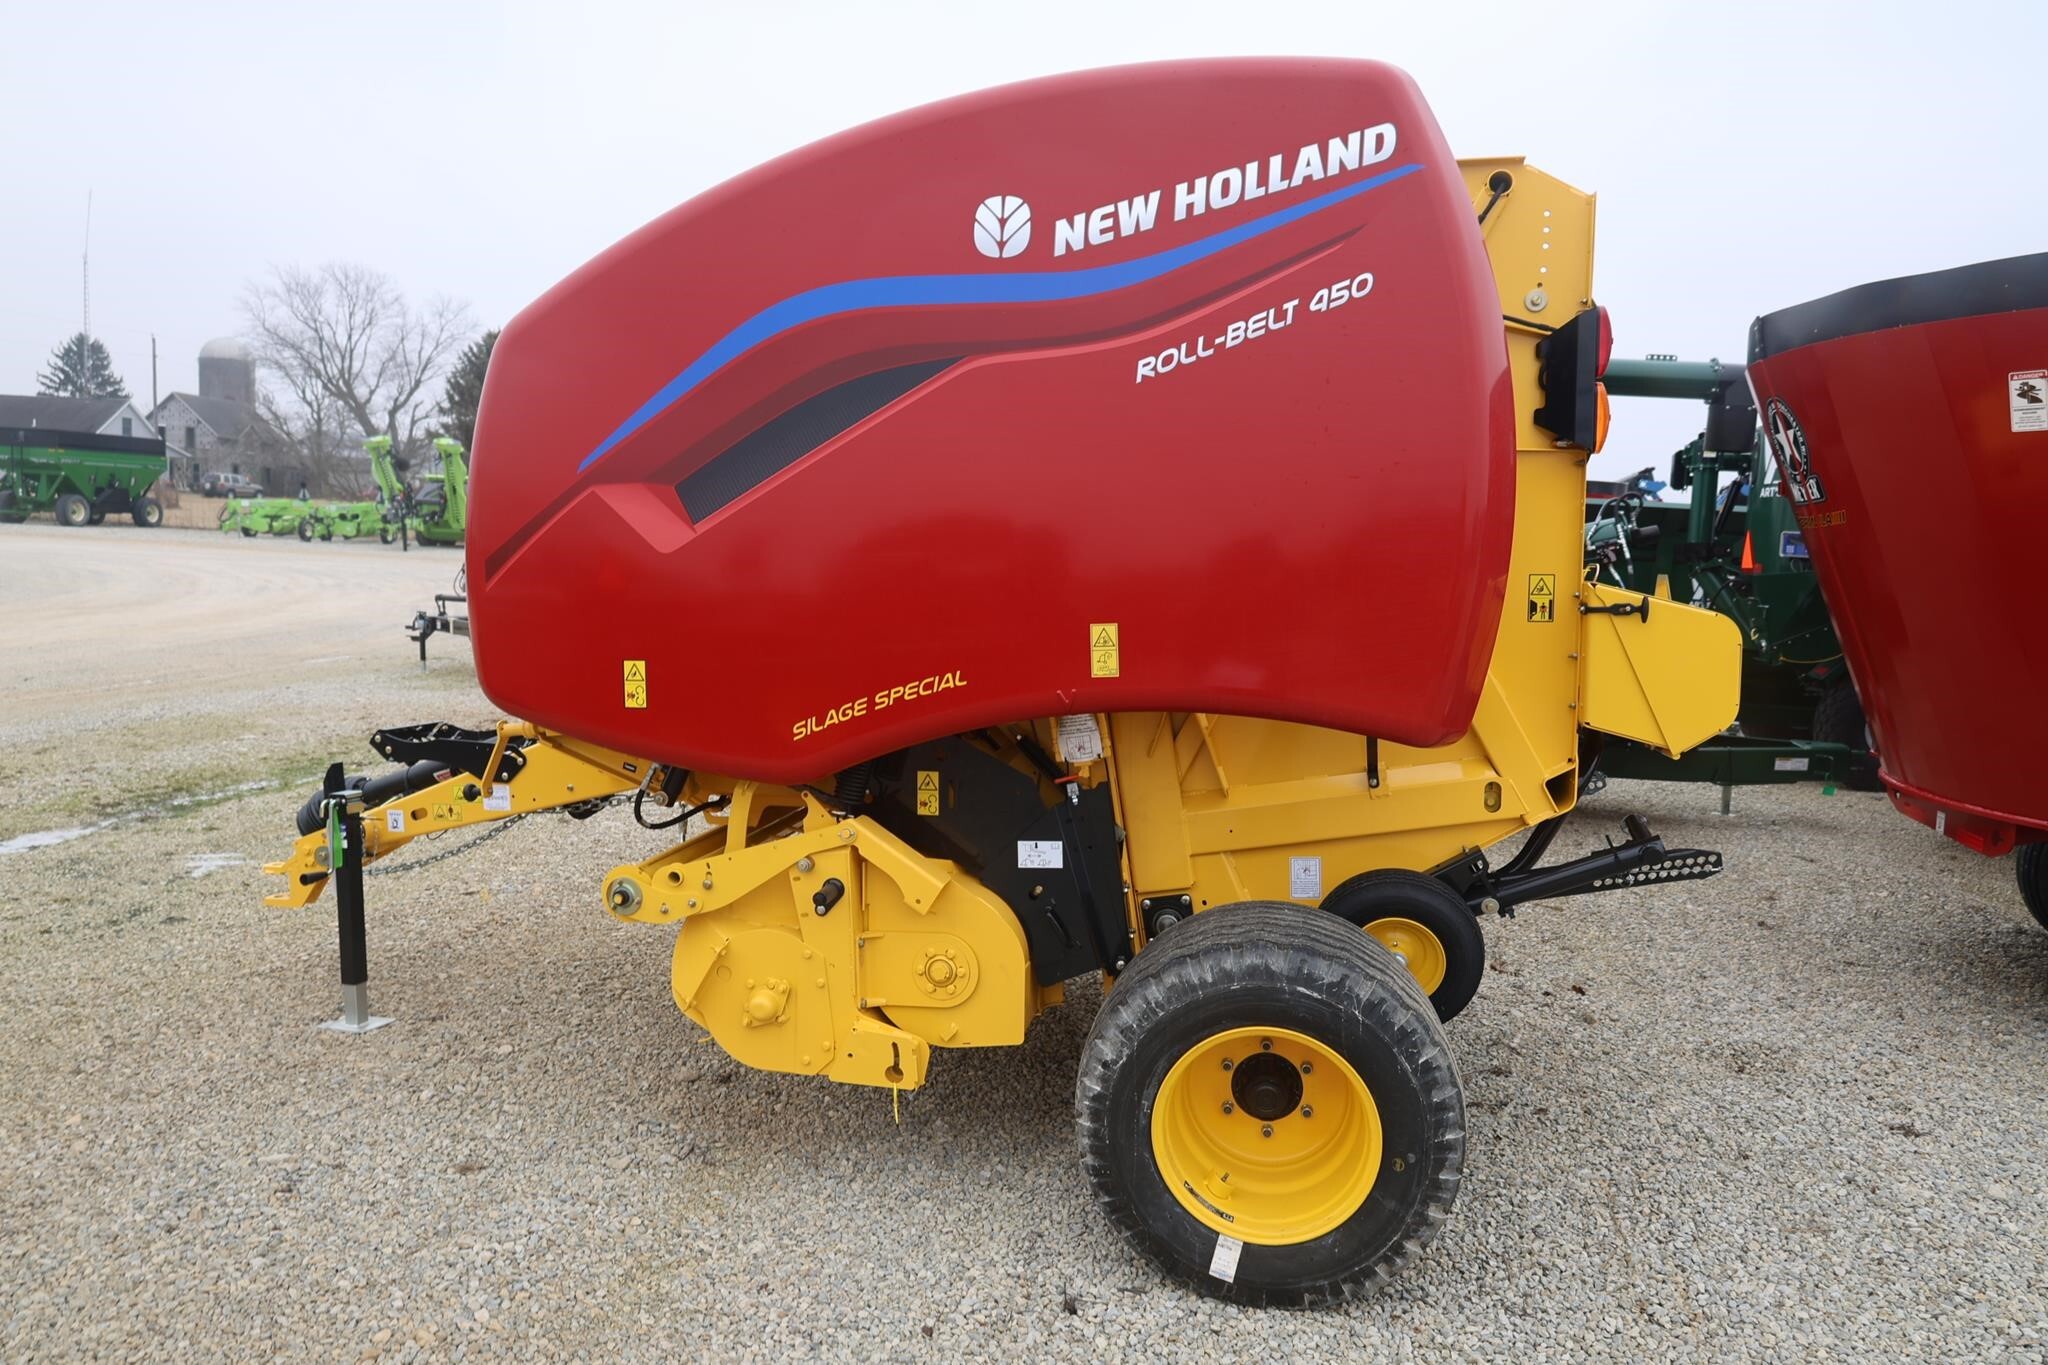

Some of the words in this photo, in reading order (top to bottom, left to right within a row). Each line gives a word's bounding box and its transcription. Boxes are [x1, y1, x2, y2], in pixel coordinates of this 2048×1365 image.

[1053, 189, 1161, 257] NEW
[1173, 122, 1397, 222] HOLLAND
[1135, 298, 1300, 384] ROLL-BELT
[1309, 272, 1374, 313] 450
[792, 697, 868, 741] SILAGE
[874, 670, 967, 710] SPECIAL
